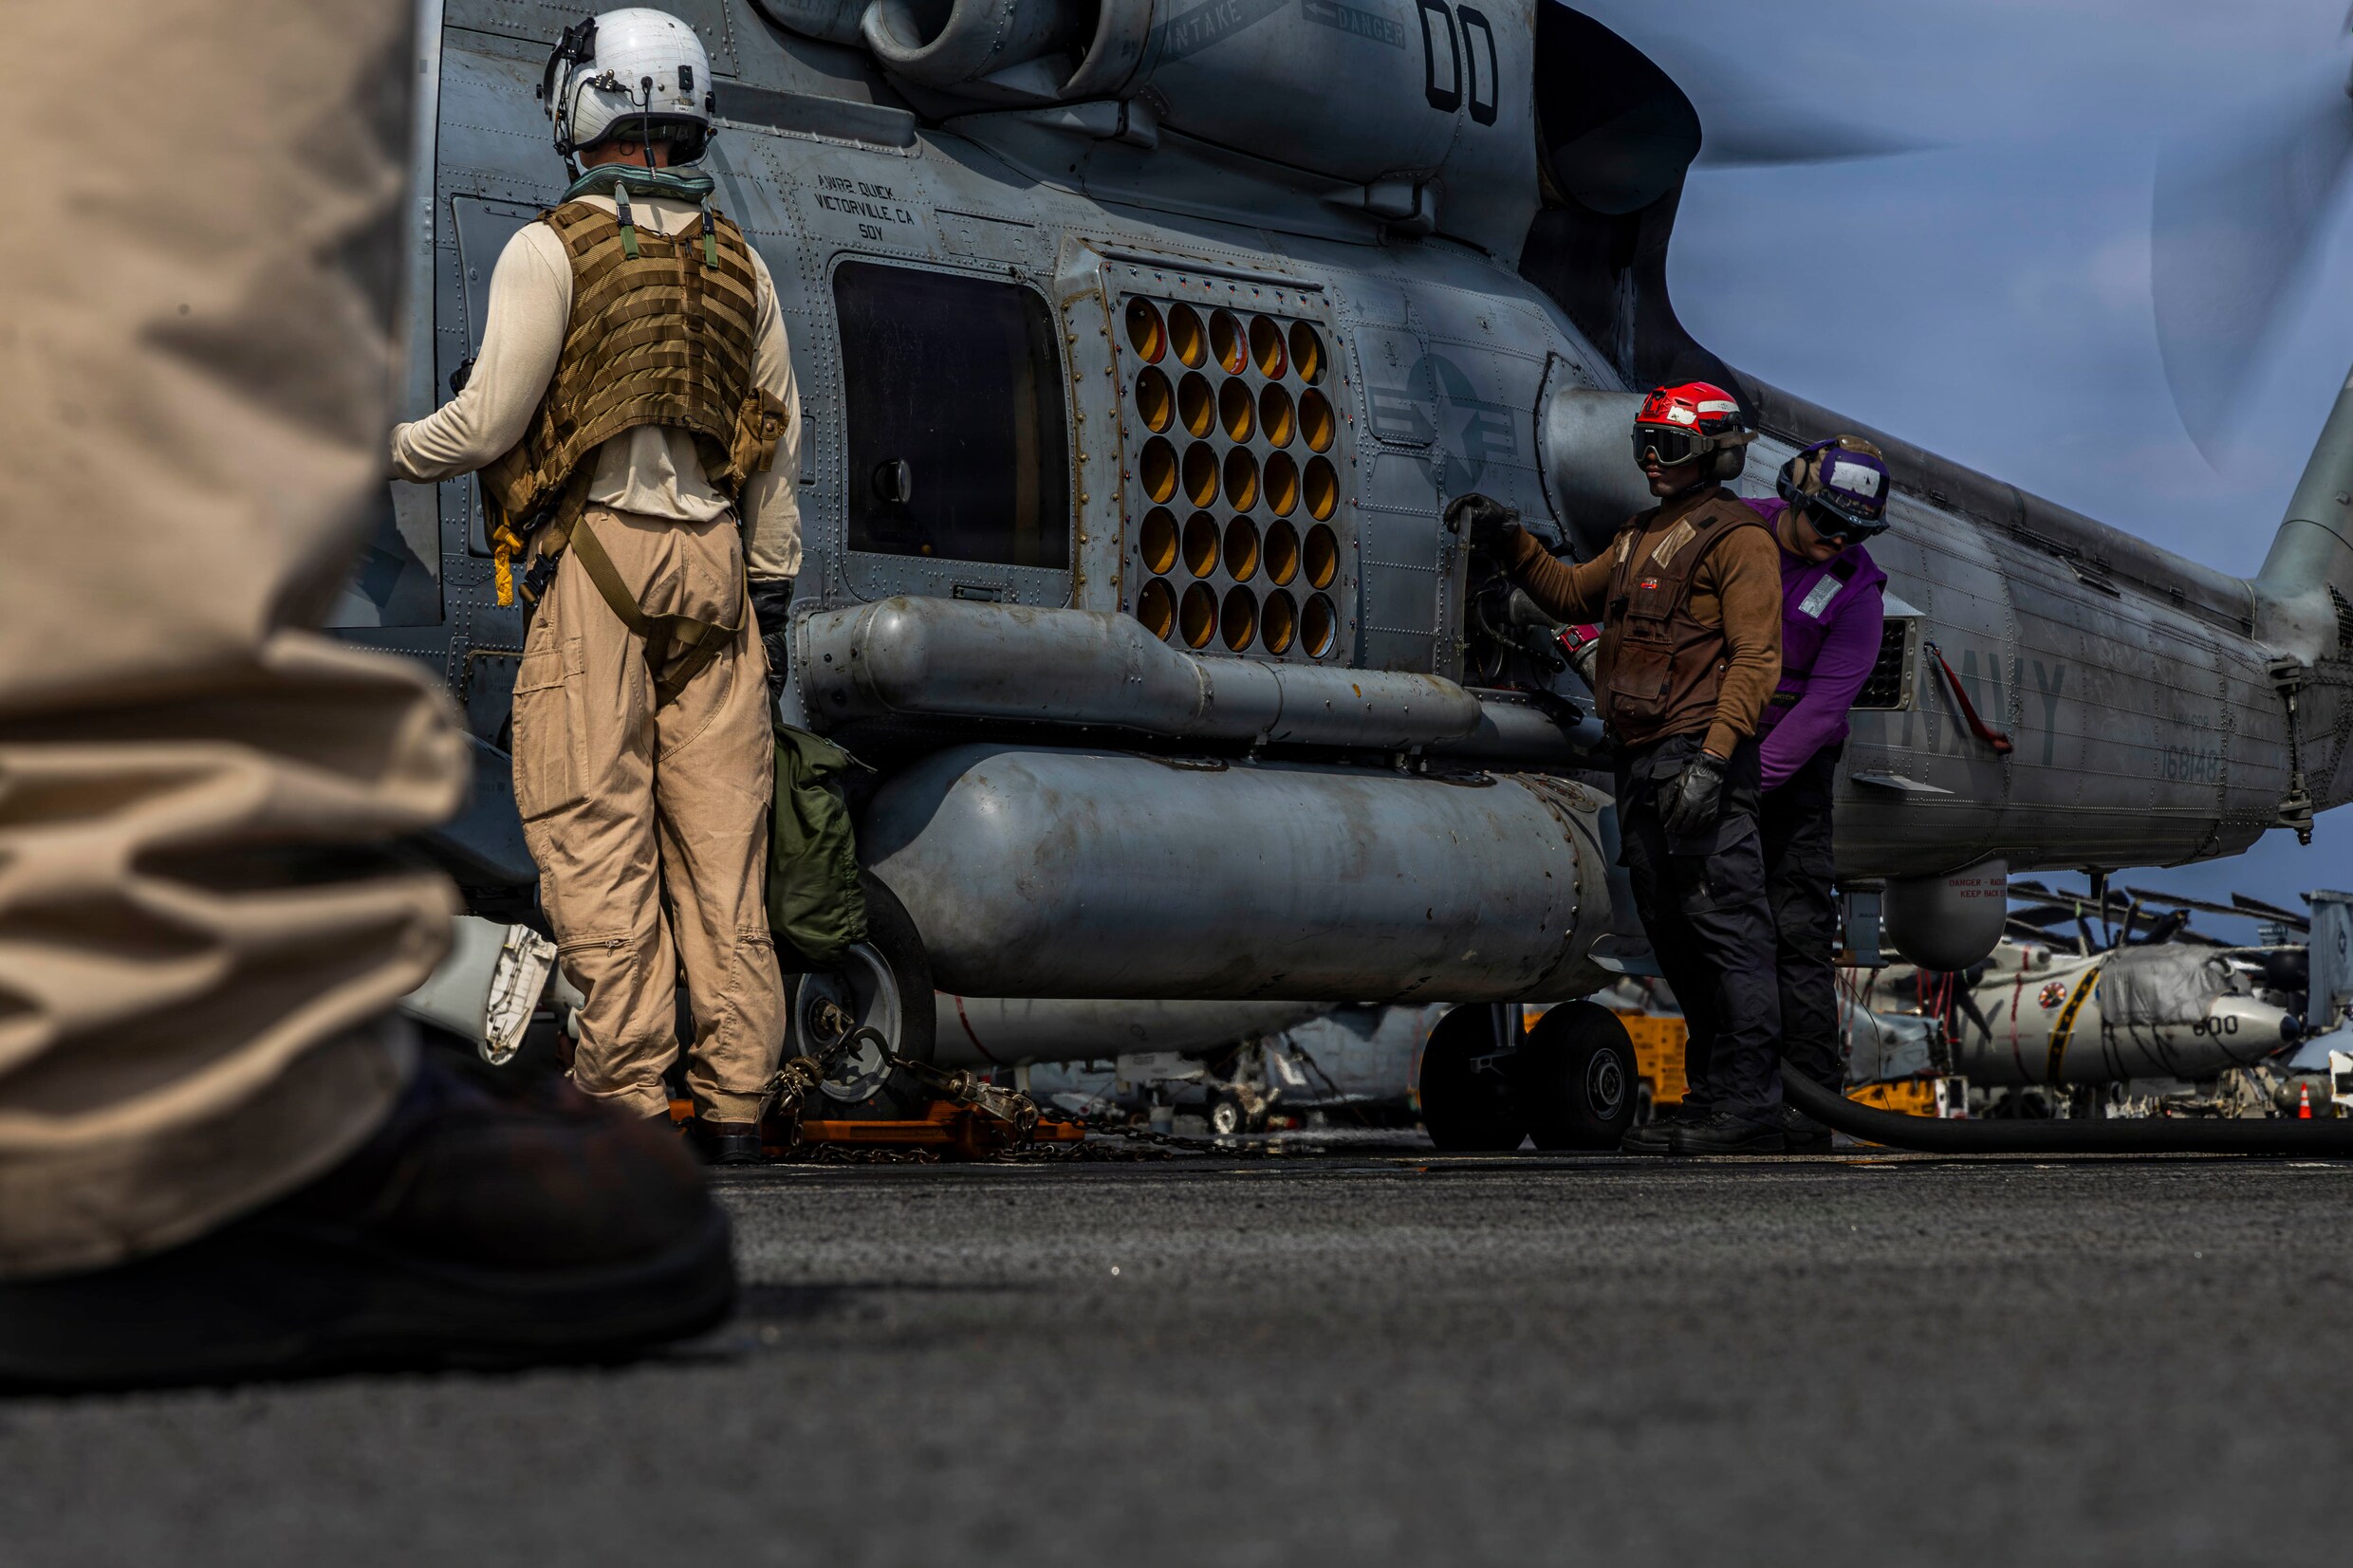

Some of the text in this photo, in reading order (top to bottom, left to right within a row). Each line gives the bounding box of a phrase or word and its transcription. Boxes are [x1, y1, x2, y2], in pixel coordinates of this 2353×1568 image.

[1164, 3, 1242, 54] INTAKE
[1336, 6, 1405, 46] DANGER
[1416, 0, 1498, 127] 00
[818, 175, 896, 201] AWR2 QUICK
[814, 193, 915, 226] VICTORVILLE, CA
[1901, 647, 2066, 766] NAVY
[1949, 878, 1981, 887] DANGER
[1984, 889, 1998, 897] BACK
